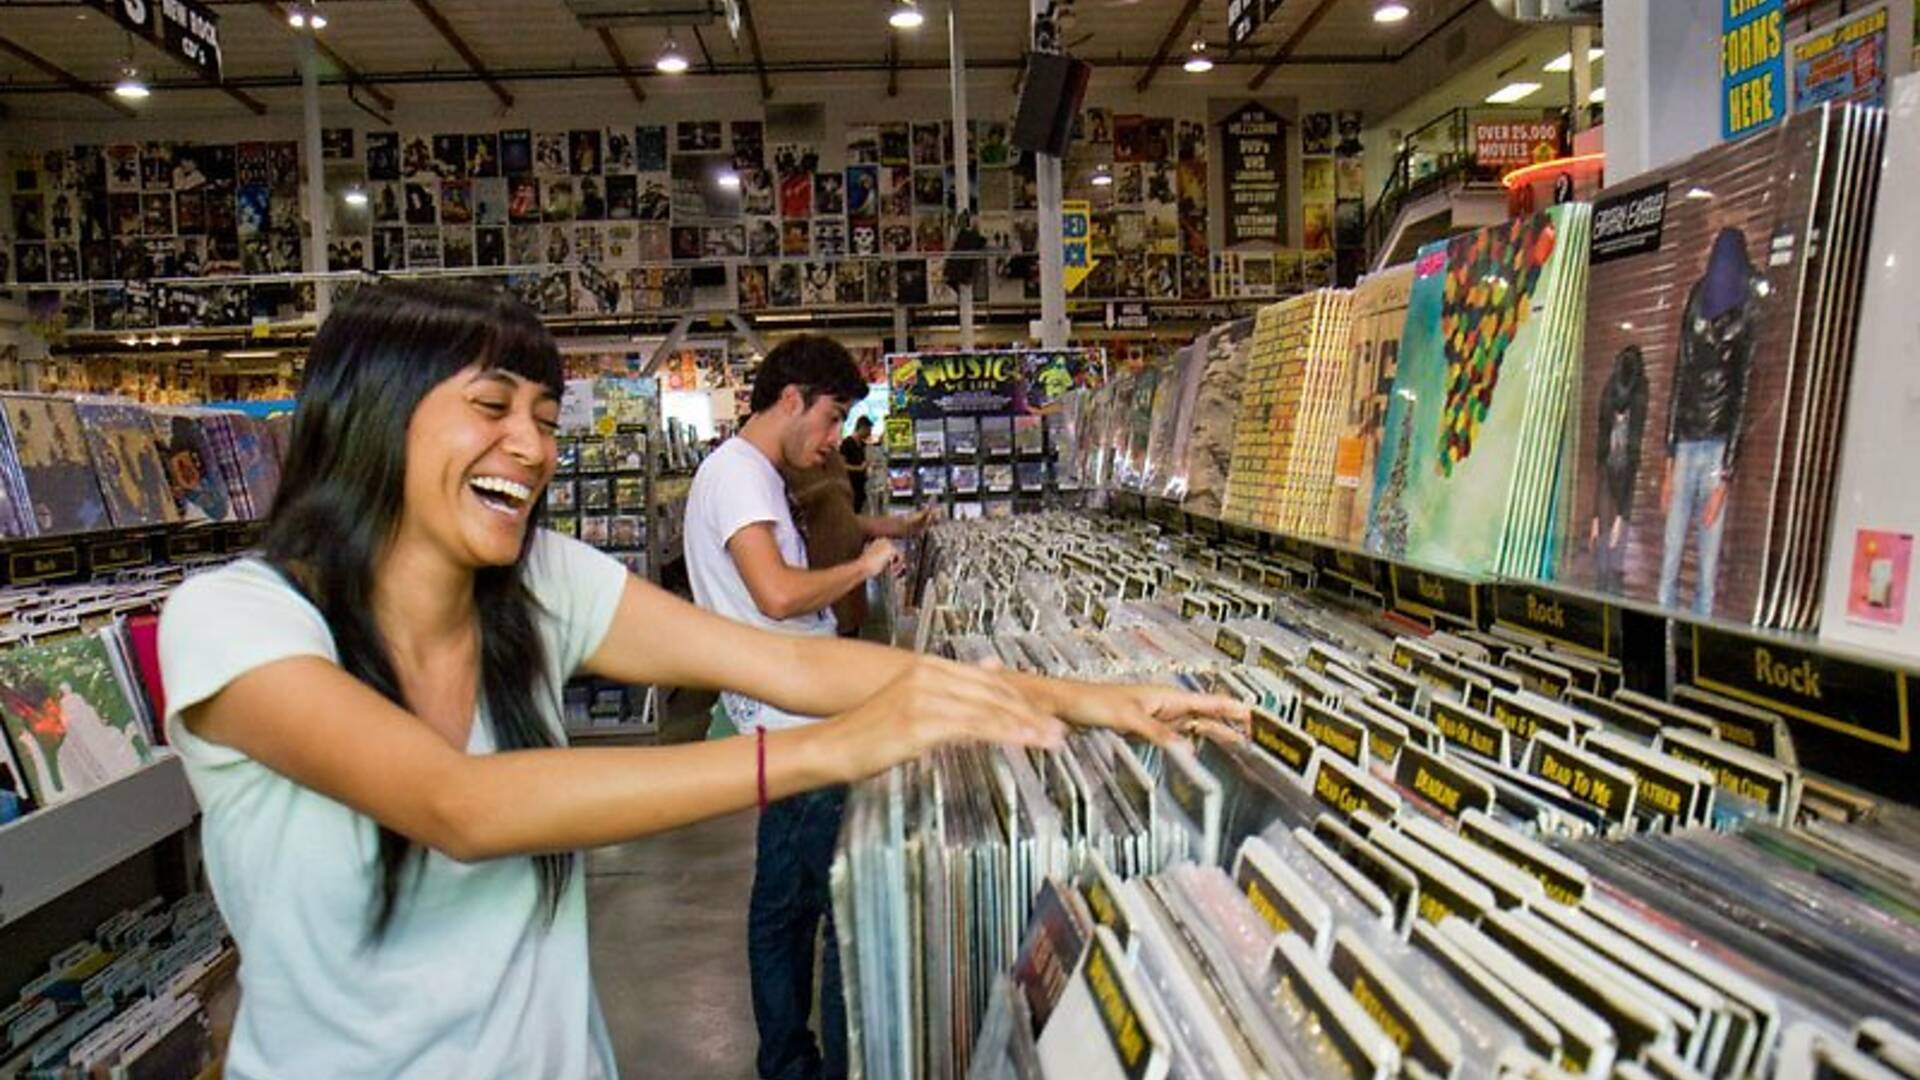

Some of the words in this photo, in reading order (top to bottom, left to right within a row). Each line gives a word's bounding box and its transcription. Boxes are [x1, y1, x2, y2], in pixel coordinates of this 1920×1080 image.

[1729, 73, 1773, 132] HERE
[1478, 125, 1509, 139] OVER
[1479, 142, 1528, 158] MOVIES
[923, 356, 1012, 387] MUSIC
[1527, 593, 1565, 629] Rock
[1755, 646, 1822, 699] Rock
